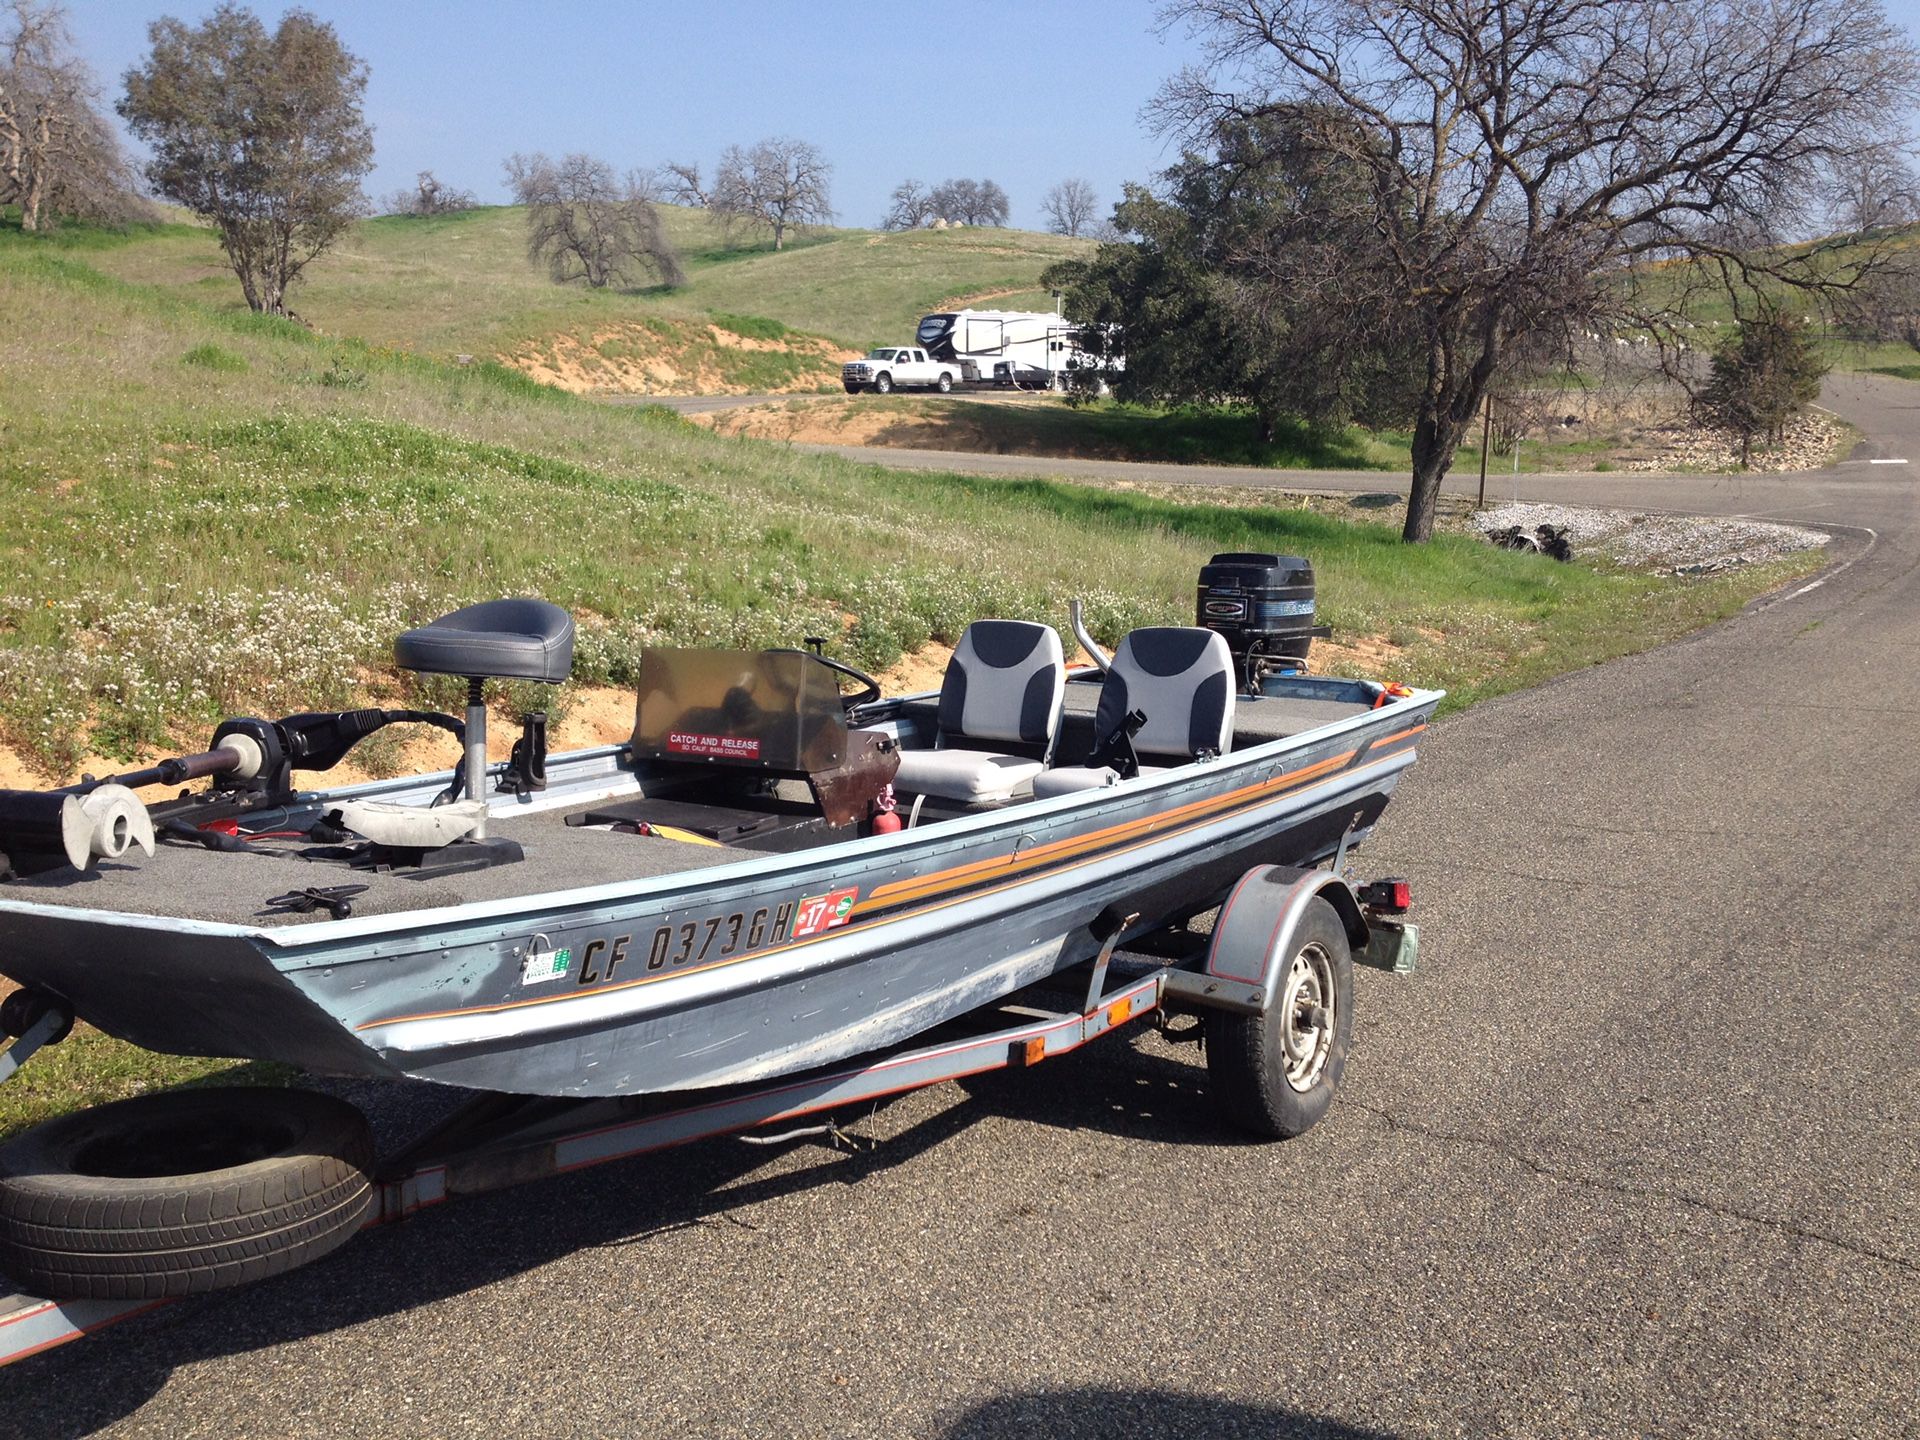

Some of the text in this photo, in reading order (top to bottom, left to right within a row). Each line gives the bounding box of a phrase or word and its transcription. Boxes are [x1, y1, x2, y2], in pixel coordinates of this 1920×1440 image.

[670, 734, 759, 750] CATCH AND RELEASE
[724, 748, 748, 756] COUNCIL
[806, 902, 827, 928] 17
[577, 934, 632, 985] CF
[647, 901, 794, 971] 0373GH
